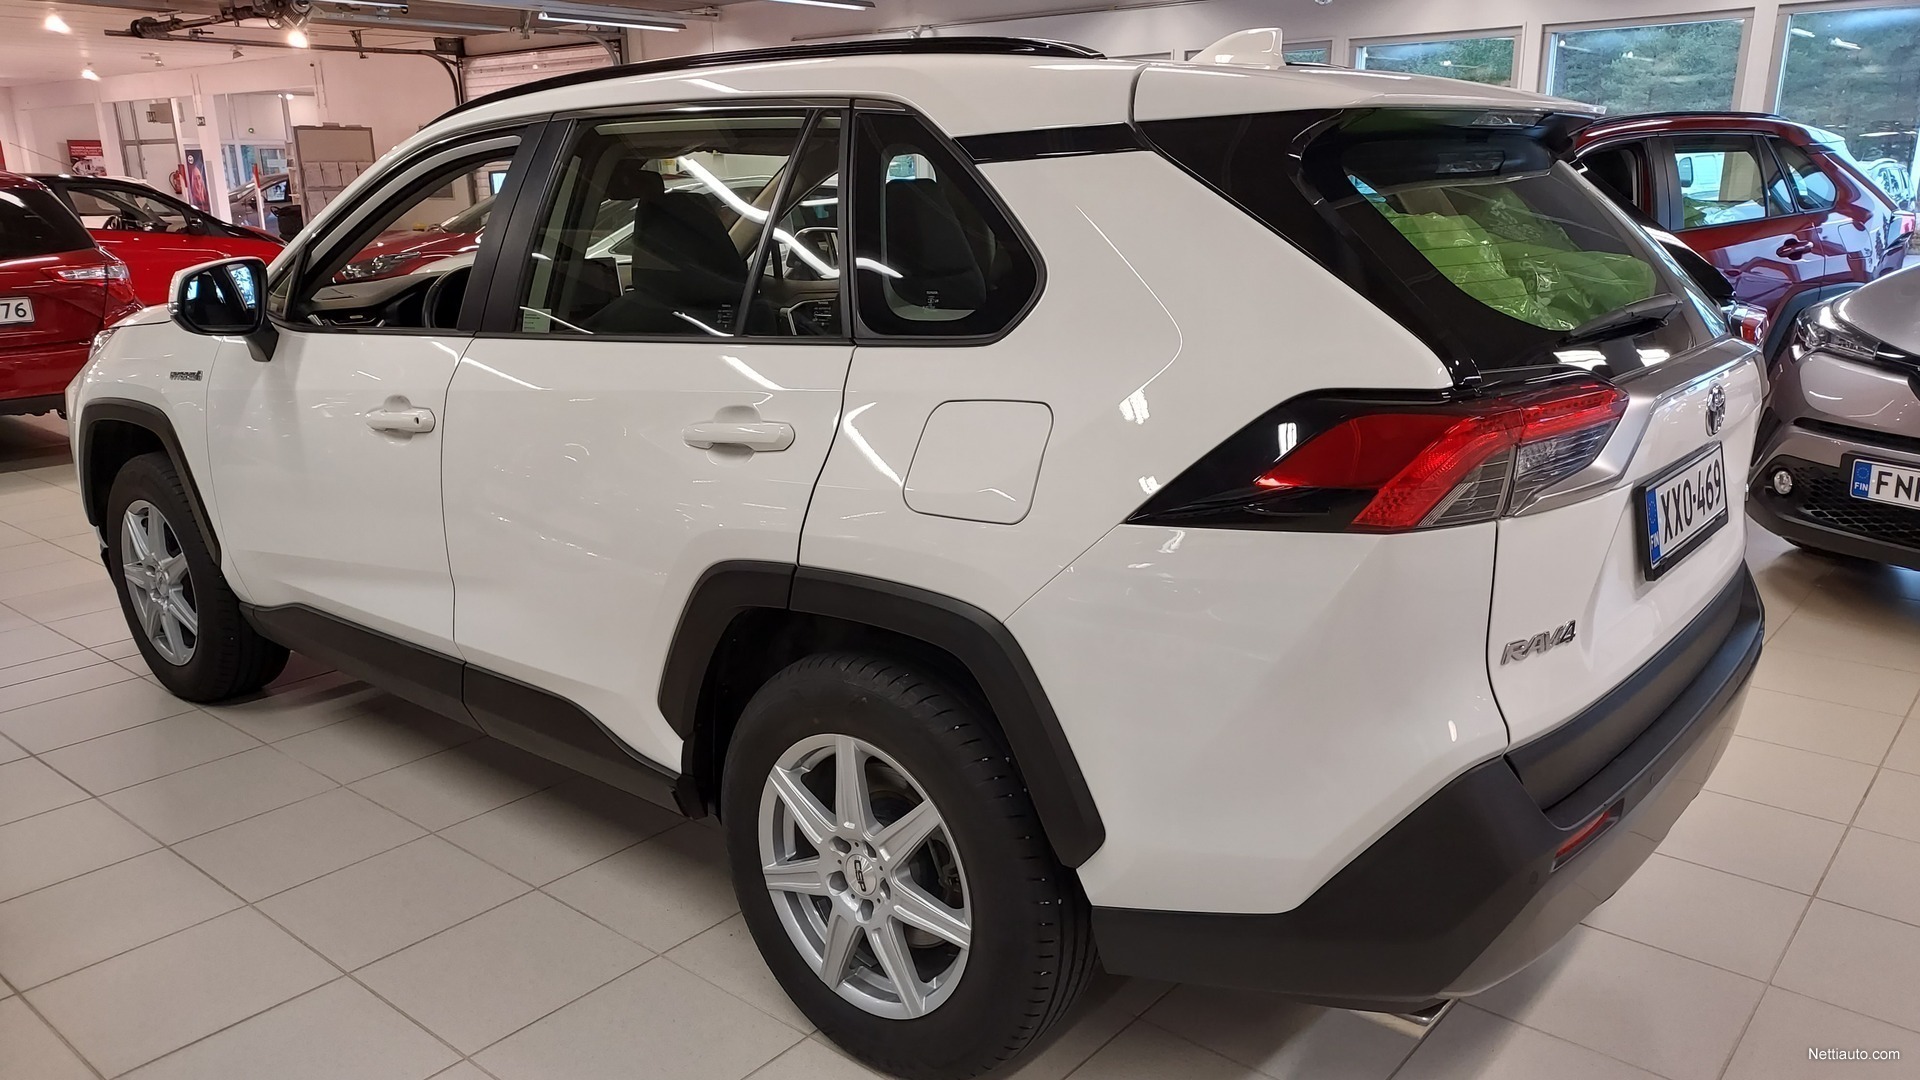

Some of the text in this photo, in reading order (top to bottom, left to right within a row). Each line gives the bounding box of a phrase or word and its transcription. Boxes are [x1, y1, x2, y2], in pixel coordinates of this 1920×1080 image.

[0, 302, 27, 318] 76
[1854, 481, 1868, 492] FIN
[1660, 459, 1721, 544] XXO-469
[1650, 530, 1660, 550] FIN
[1500, 619, 1577, 666] RAV4
